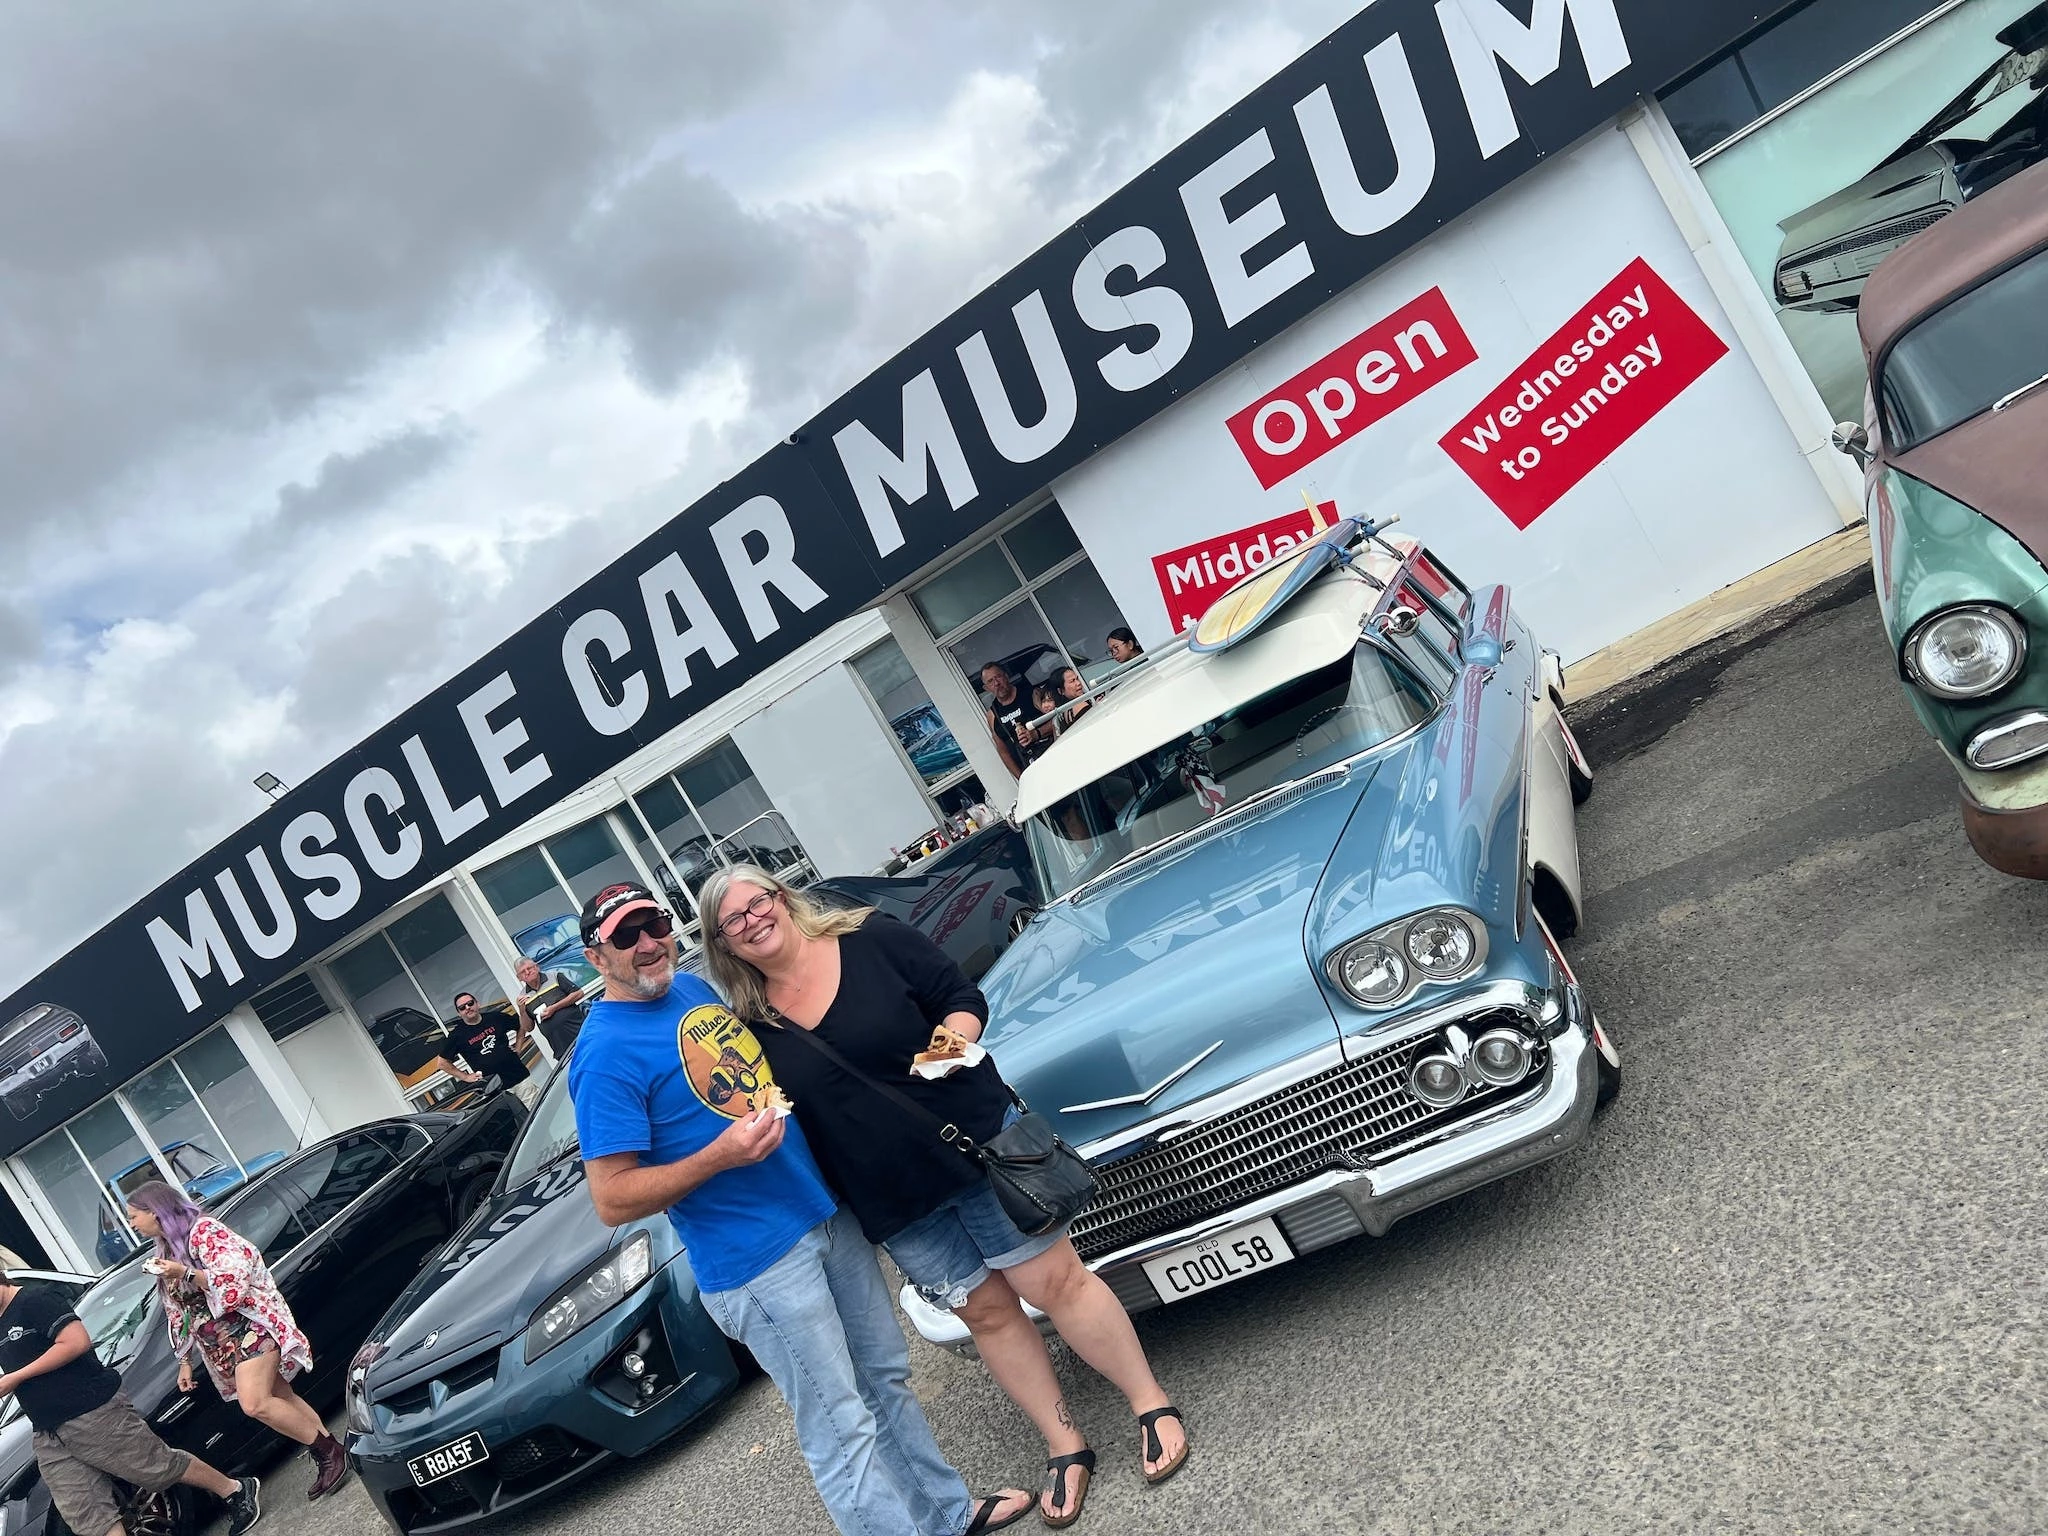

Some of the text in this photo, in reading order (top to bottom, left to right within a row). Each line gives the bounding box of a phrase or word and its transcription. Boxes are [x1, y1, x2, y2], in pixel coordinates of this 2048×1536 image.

[1252, 315, 1448, 456] Open
[1460, 284, 1649, 454] Wednesday
[1500, 333, 1662, 481] to Sunday
[144, 0, 1632, 1013] MUSCLE CAR MUSEUM
[1165, 1235, 1274, 1293] COOL58
[1196, 1239, 1219, 1253] QLD
